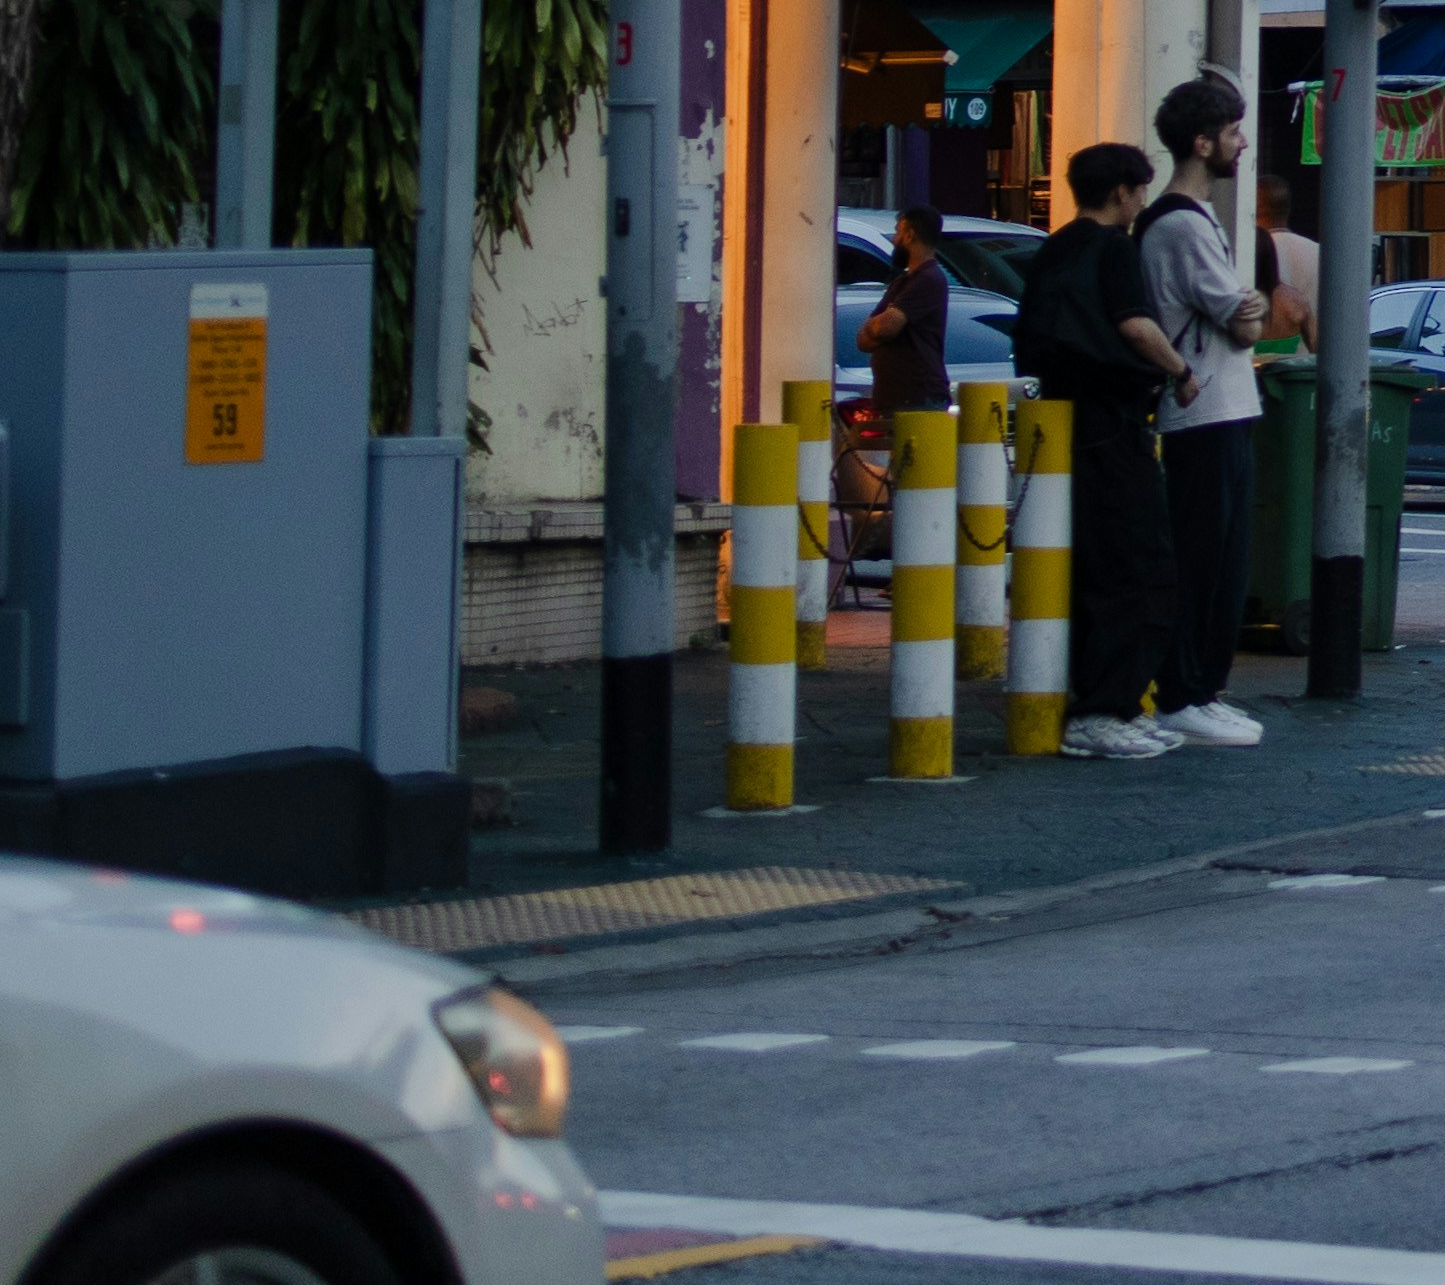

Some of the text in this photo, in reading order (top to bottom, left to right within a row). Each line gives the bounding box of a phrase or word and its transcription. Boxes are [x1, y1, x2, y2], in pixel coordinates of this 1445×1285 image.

[616, 22, 633, 66] 3
[1331, 68, 1346, 102] 7
[212, 403, 238, 436] 59
